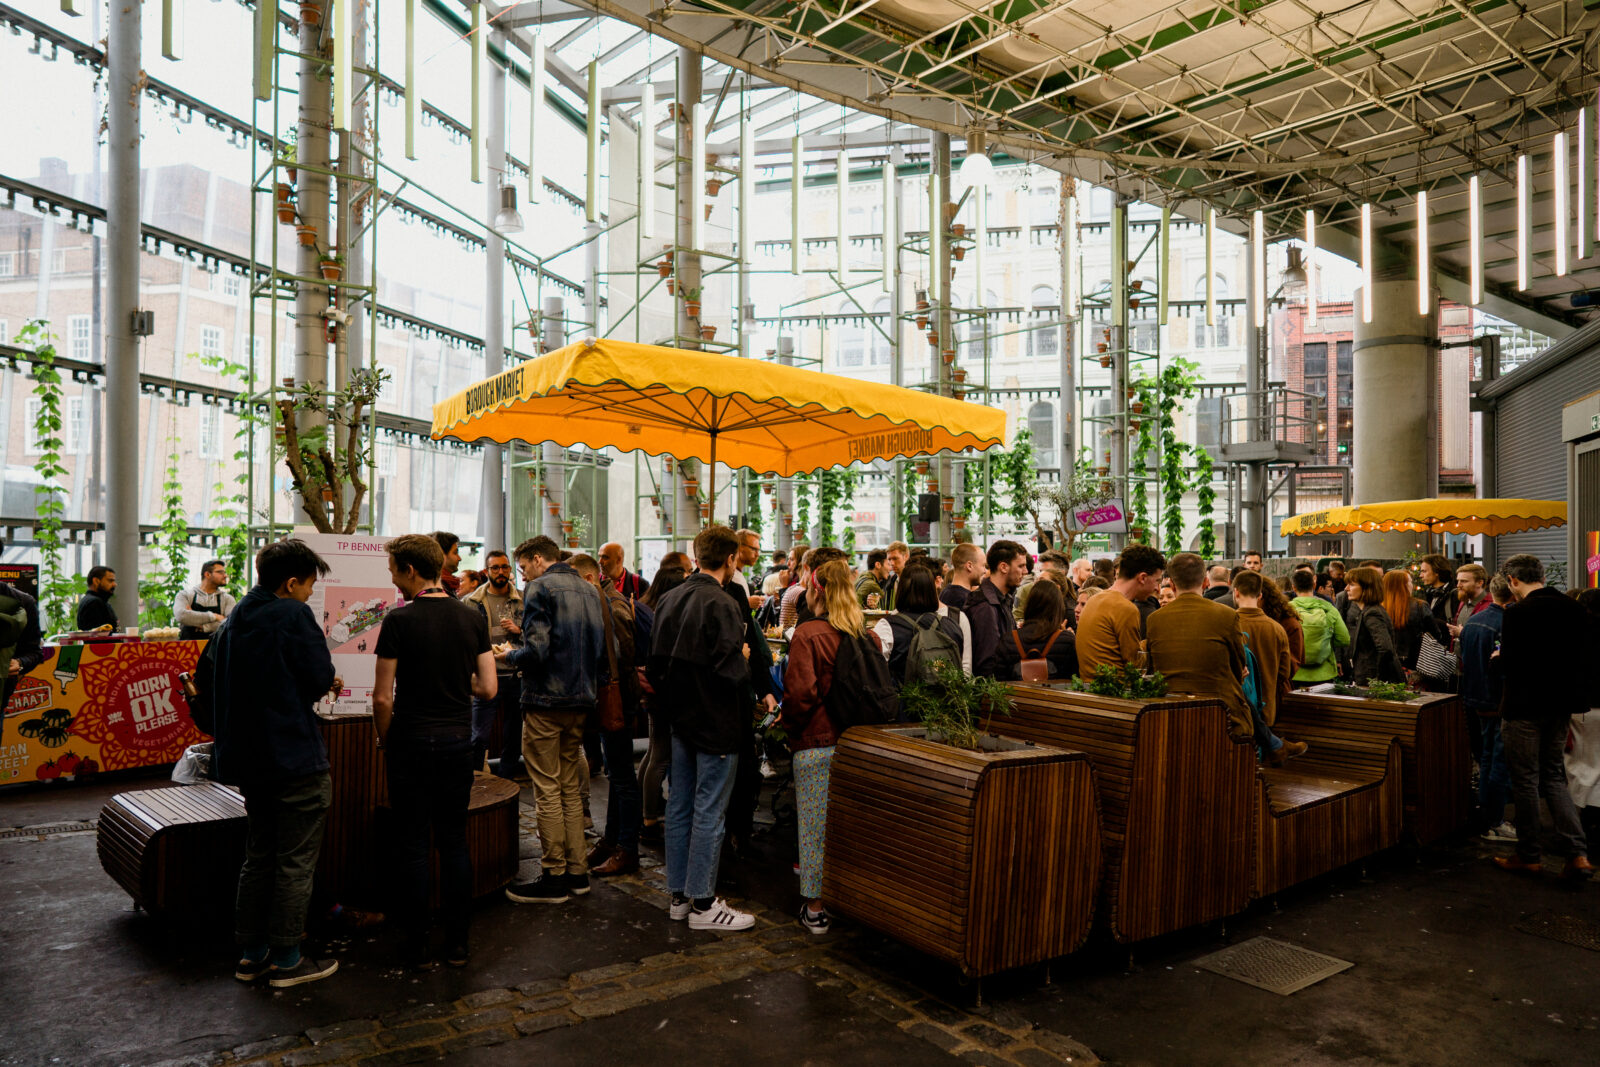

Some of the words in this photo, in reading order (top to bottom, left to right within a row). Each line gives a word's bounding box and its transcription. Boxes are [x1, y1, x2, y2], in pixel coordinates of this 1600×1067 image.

[466, 380, 494, 415] BOROUGH
[495, 367, 524, 403] MARKET
[337, 541, 349, 550] TP
[351, 542, 383, 552] BENNE
[129, 662, 167, 676] STREET
[127, 672, 171, 699] HORN
[129, 687, 176, 723] OK
[133, 721, 187, 746] VEGETARIAN
[135, 711, 179, 734] PLEASE
